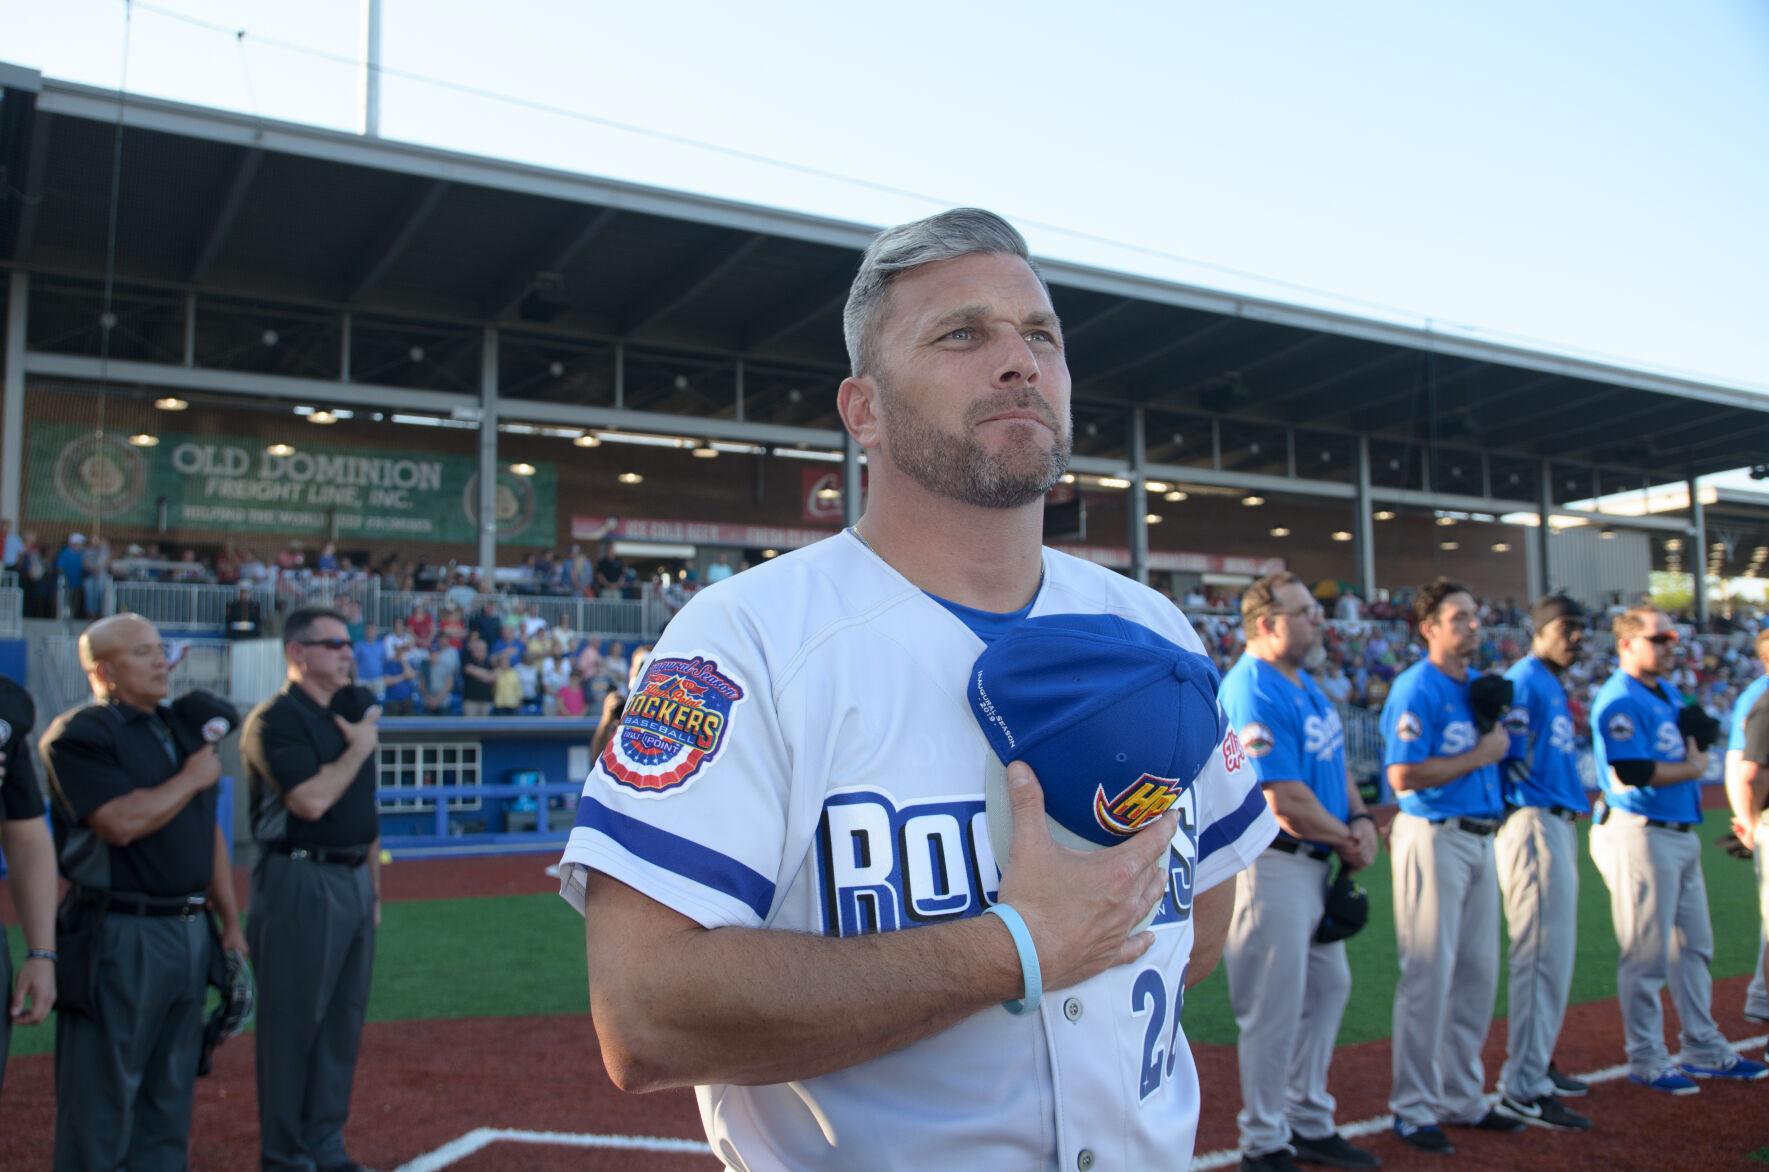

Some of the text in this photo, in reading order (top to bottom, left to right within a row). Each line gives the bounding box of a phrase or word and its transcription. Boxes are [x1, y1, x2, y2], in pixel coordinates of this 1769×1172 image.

[171, 442, 443, 490] OLD DOMINION
[204, 478, 301, 502] FREIGHT
[367, 489, 414, 510] INC.
[693, 664, 738, 698] Season
[624, 696, 720, 749] OCKERS
[977, 670, 1016, 748] INAUGURAL SEASON
[980, 702, 996, 722] 2019
[624, 717, 695, 745] BASEBALL
[645, 736, 680, 754] POINT
